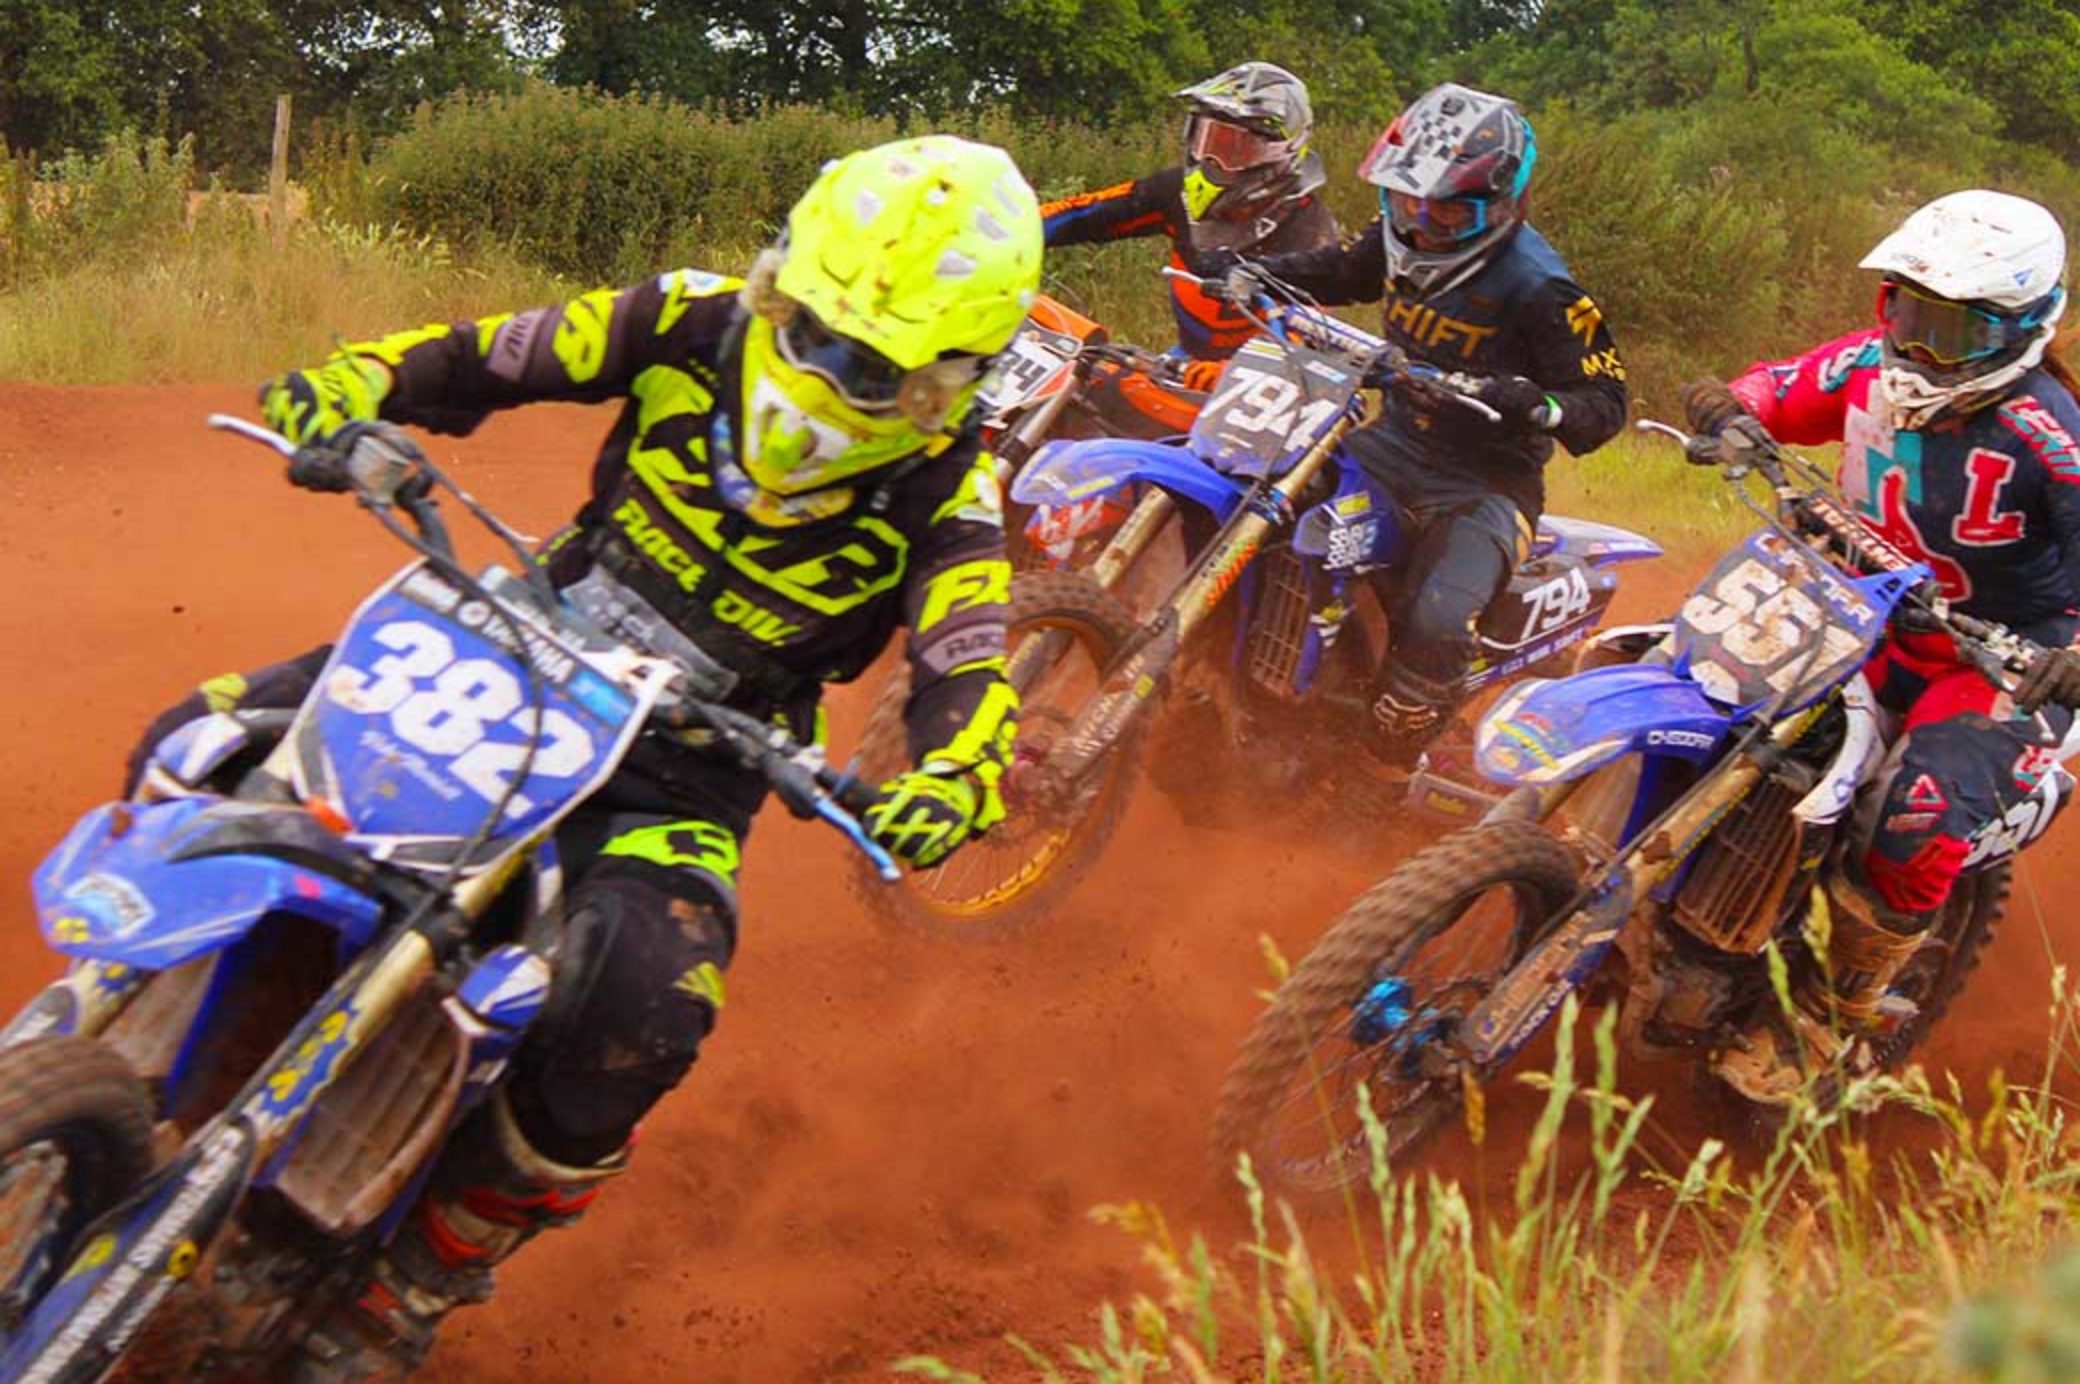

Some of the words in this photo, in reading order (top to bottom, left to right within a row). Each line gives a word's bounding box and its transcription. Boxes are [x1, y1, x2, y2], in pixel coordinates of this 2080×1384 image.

[1200, 366, 1340, 453] 794
[612, 498, 707, 593] RACE
[1520, 567, 1591, 641] 794
[327, 620, 596, 819] 382
